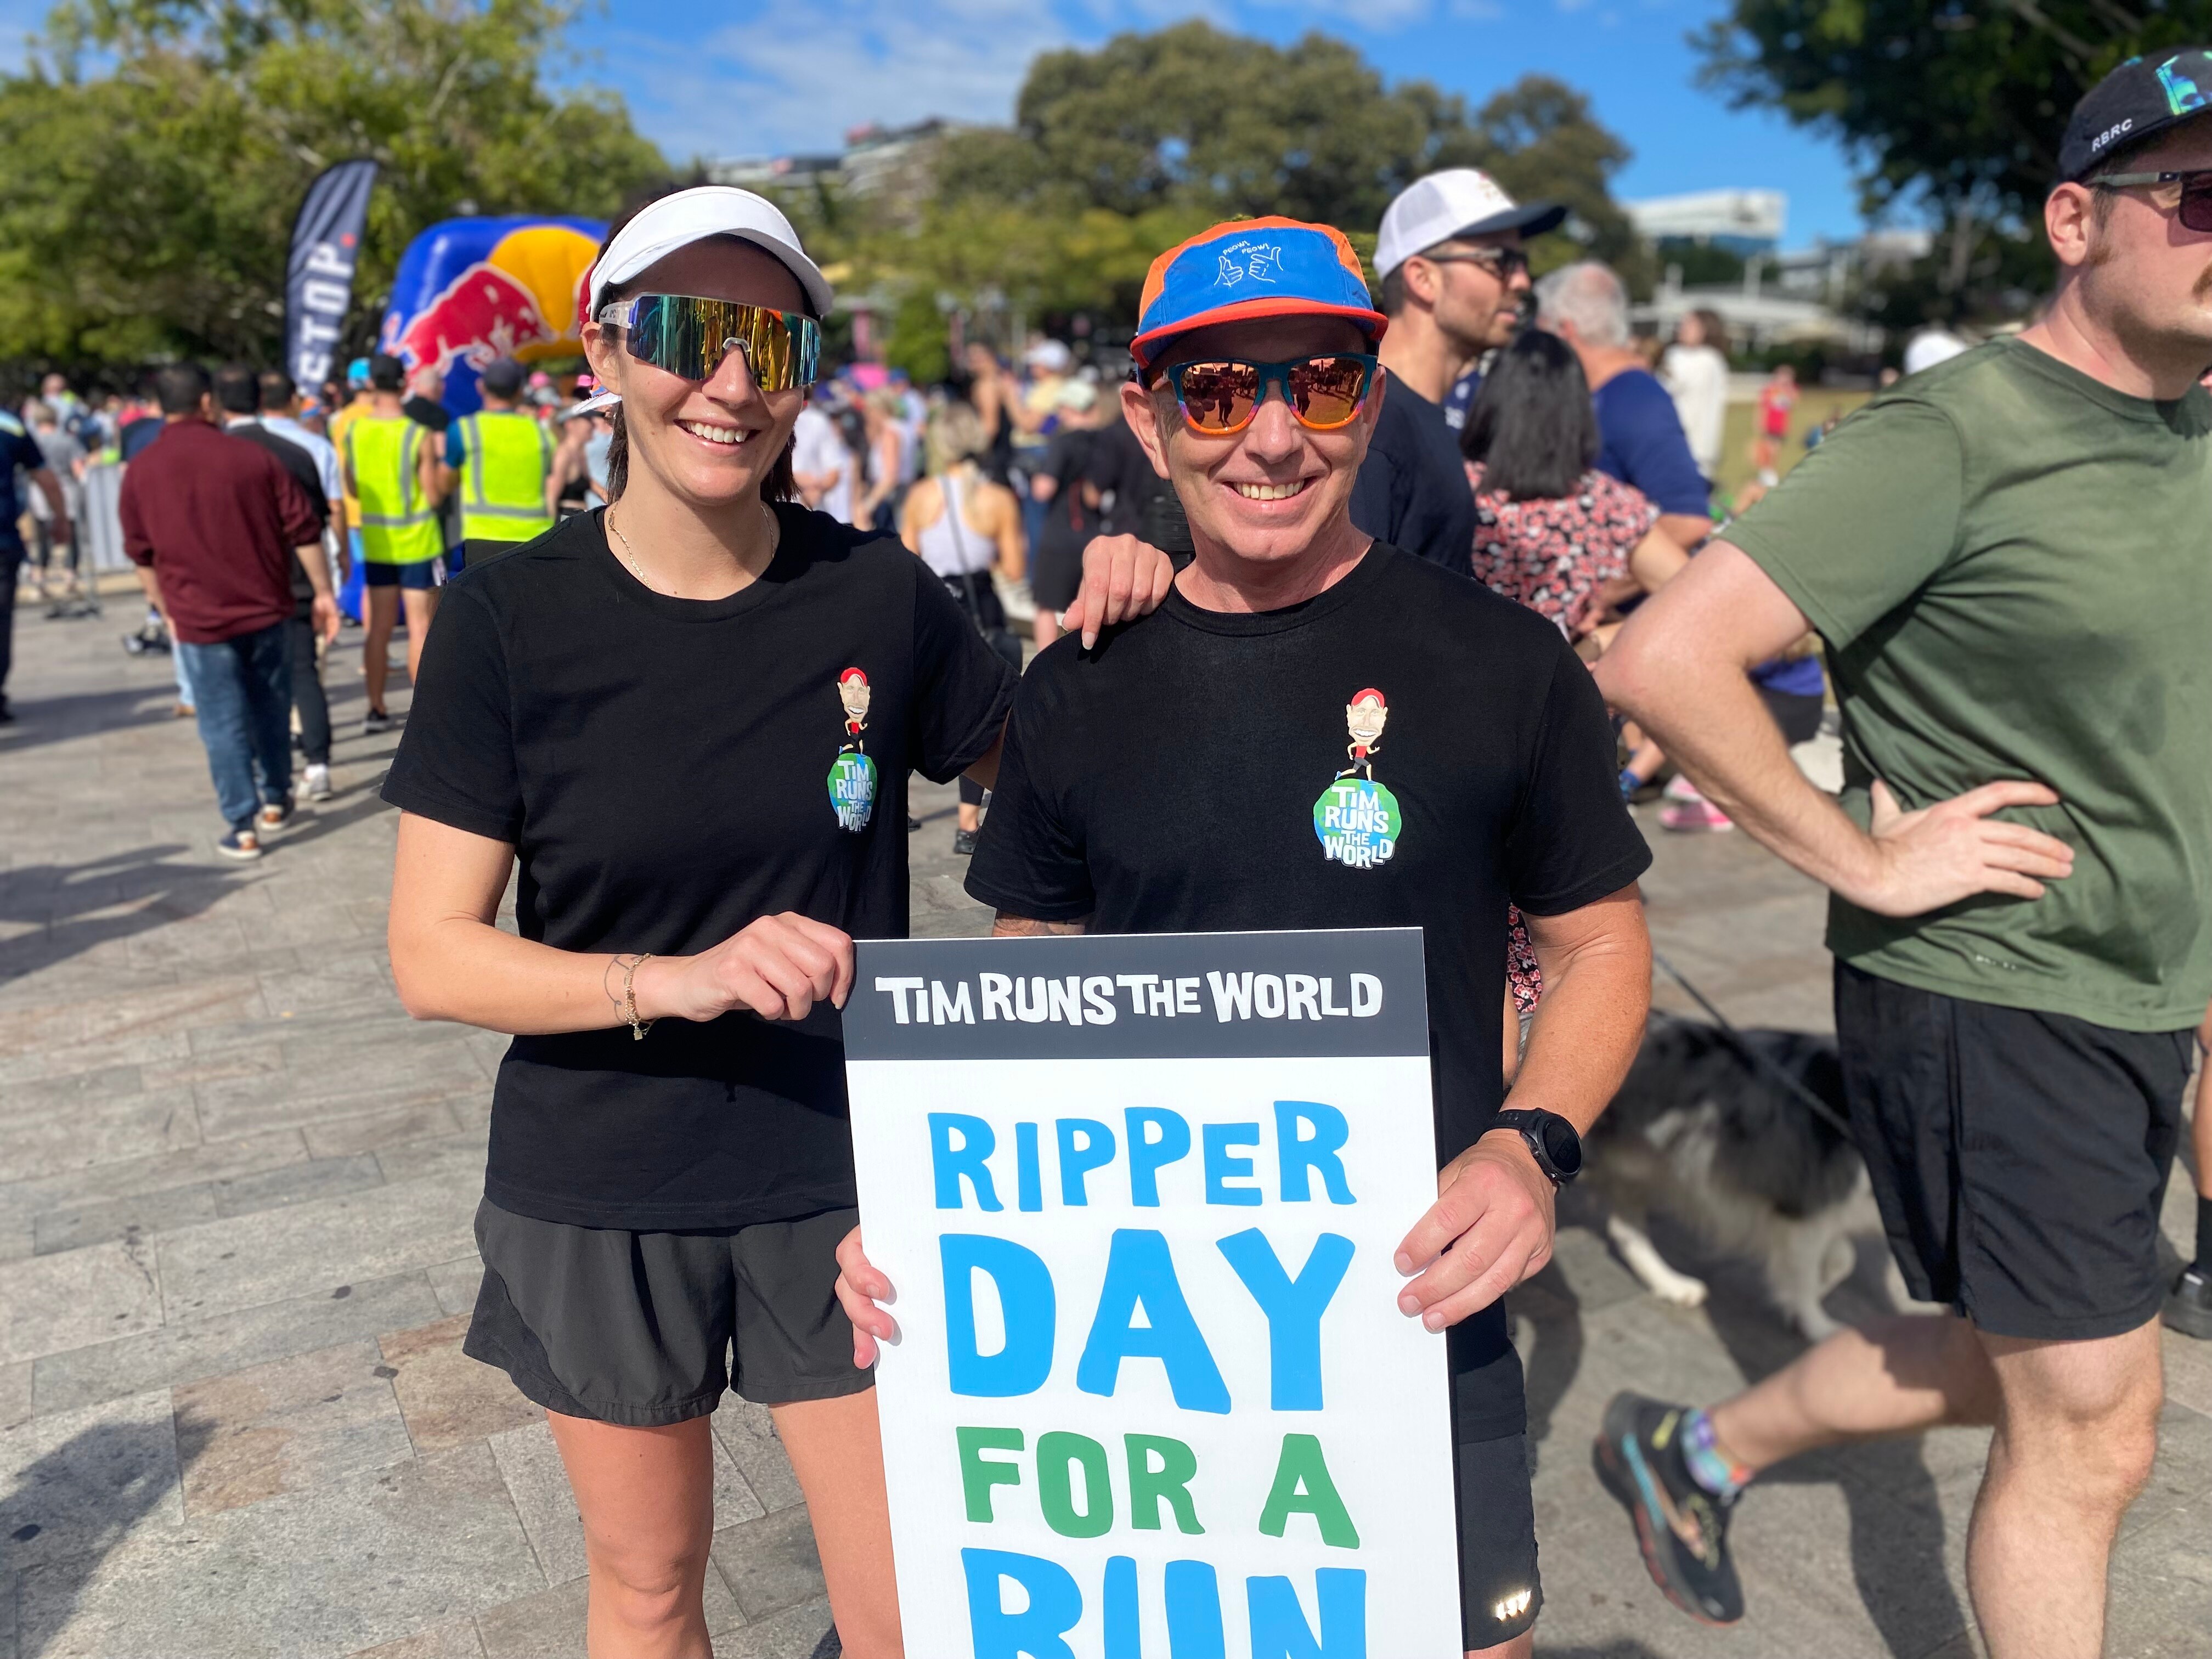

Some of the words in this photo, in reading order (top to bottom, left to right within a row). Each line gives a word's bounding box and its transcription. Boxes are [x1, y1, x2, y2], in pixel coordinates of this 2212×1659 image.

[2092, 118, 2132, 152] RBRC
[1222, 240, 1251, 255] PEOW!
[1242, 242, 1270, 254] PEOW!
[837, 760, 870, 782] TIM
[836, 778, 873, 801] RUNS
[1331, 786, 1379, 811] TIM
[837, 805, 872, 832] WORLD
[849, 800, 864, 814] THE
[1324, 805, 1389, 833] RUNS
[1323, 835, 1393, 868] WORLD
[1340, 830, 1371, 846] THE
[874, 976, 977, 1026] TIM
[979, 972, 1117, 1026] RUNS
[1117, 974, 1202, 1018] THE
[1207, 970, 1383, 1023] WORLD
[927, 1099, 1357, 1212] RIPPER
[939, 1227, 1356, 1415] DAY
[956, 1426, 1206, 1539] FOR
[1259, 1433, 1360, 1549] A
[960, 1547, 1367, 1659] RUN
